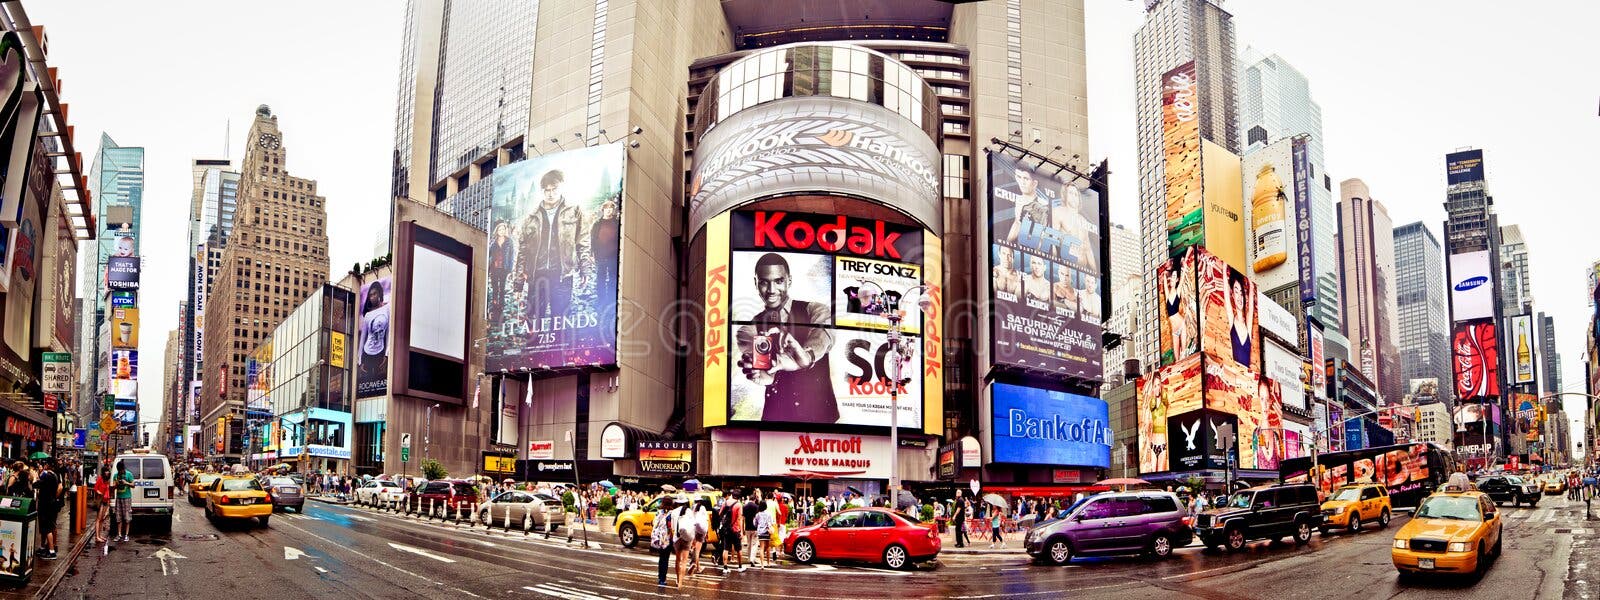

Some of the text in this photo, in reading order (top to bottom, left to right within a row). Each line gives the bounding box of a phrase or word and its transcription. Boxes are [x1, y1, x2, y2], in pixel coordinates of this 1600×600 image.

[853, 131, 939, 191] Hankook
[1294, 151, 1307, 203] TIMES
[994, 187, 1017, 203] CRU
[754, 211, 902, 259] Kodak
[1018, 215, 1082, 262] UFC
[1300, 208, 1313, 283] SQUARE
[840, 259, 917, 280] TREY SONGZ
[1458, 279, 1485, 289] SAMSUNG
[502, 322, 514, 337] IT
[554, 312, 598, 331] ENDS
[706, 264, 728, 368] Kodak
[1007, 314, 1060, 333] SATURDAY
[1062, 328, 1083, 340] JULY
[334, 337, 343, 345] THE
[538, 333, 556, 344] 7.15
[925, 280, 942, 379] Kodak
[1001, 320, 1023, 333] LIVE
[1024, 326, 1039, 337] ON
[1039, 330, 1096, 350] PAY-PER-VIEW
[332, 345, 343, 353] LION
[1009, 408, 1115, 449] Bank of Am
[794, 435, 862, 455] Marriott
[641, 461, 691, 473] WONDERLAND
[785, 457, 871, 468] NEW YORK MARQUIS
